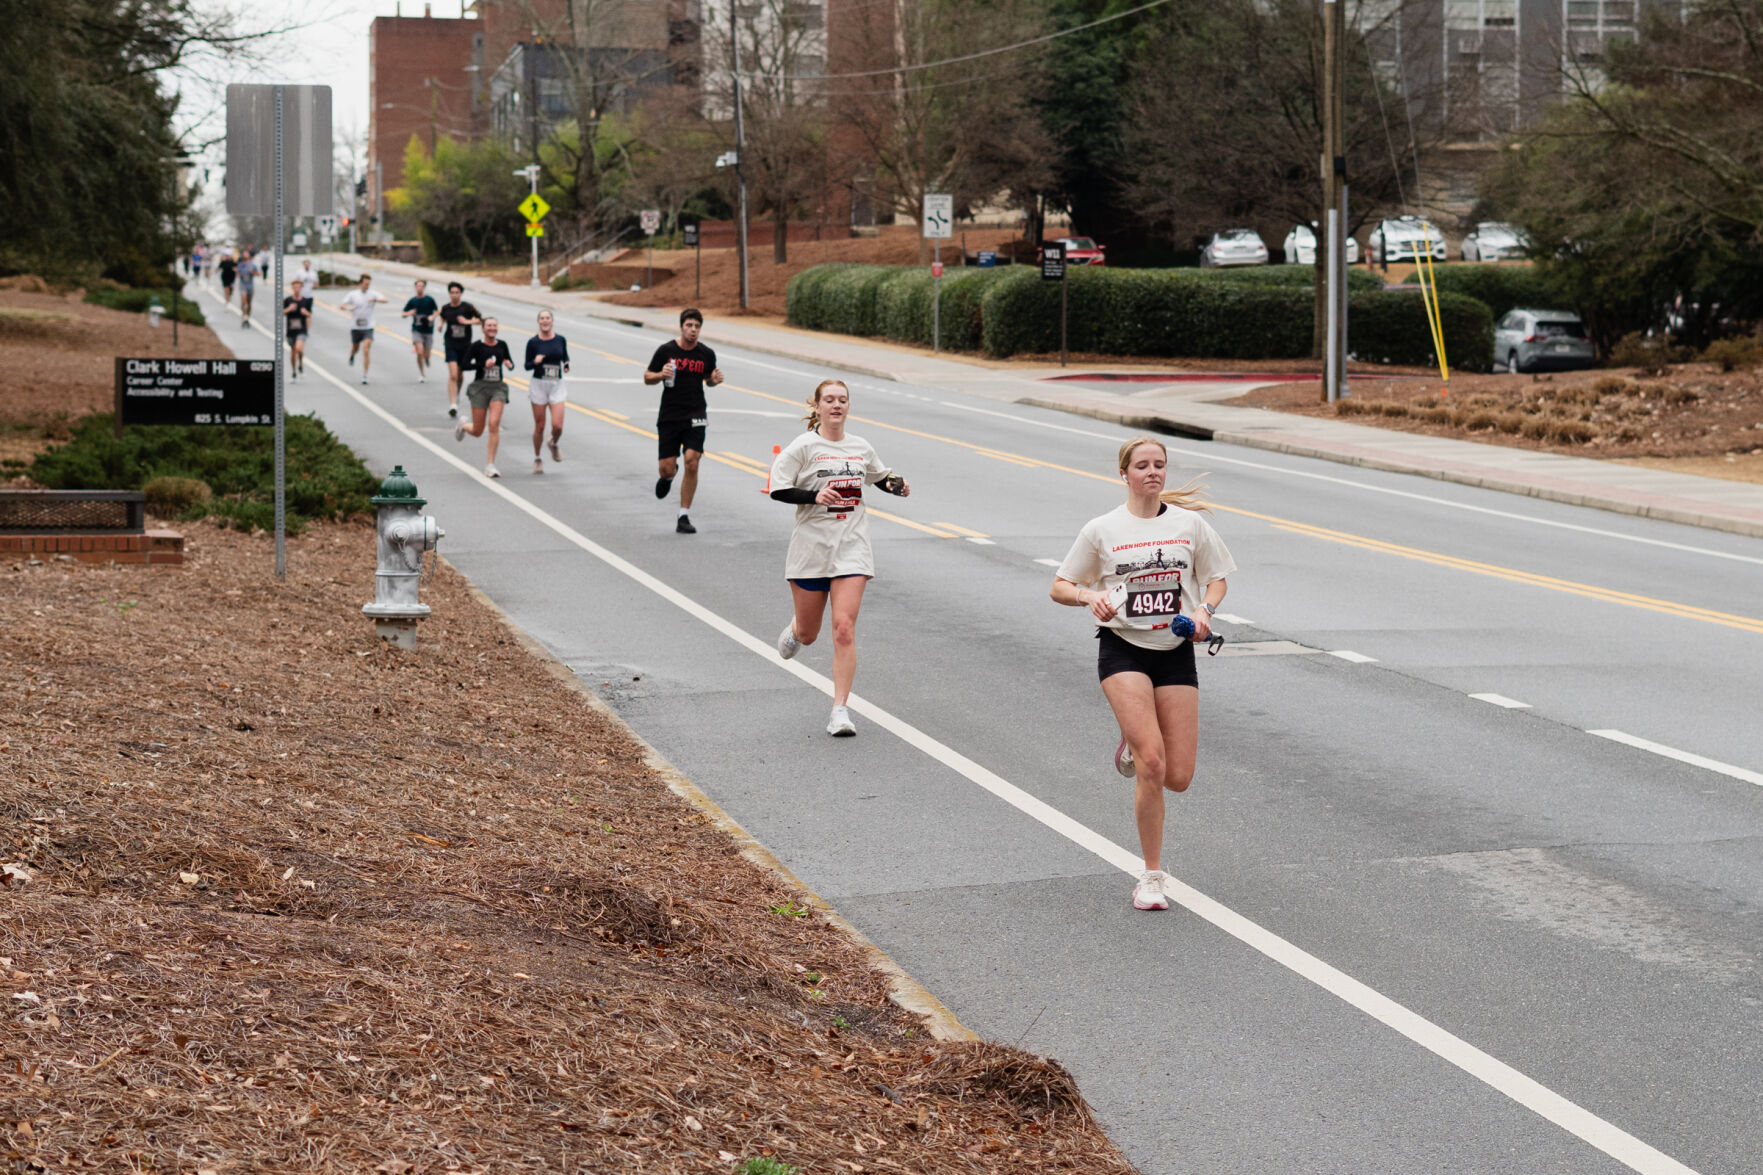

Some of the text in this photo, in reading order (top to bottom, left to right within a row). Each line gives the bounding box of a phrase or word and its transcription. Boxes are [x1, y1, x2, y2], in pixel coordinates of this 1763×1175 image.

[126, 360, 160, 374] Clark
[165, 361, 207, 374] Howell
[212, 361, 237, 375] Hall
[126, 376, 184, 386] Career Center
[178, 388, 193, 397] and
[195, 387, 224, 399] Testing
[225, 413, 258, 424] Lumpkin
[1112, 544, 1133, 552] LAKEN
[1132, 592, 1174, 613] 4942
